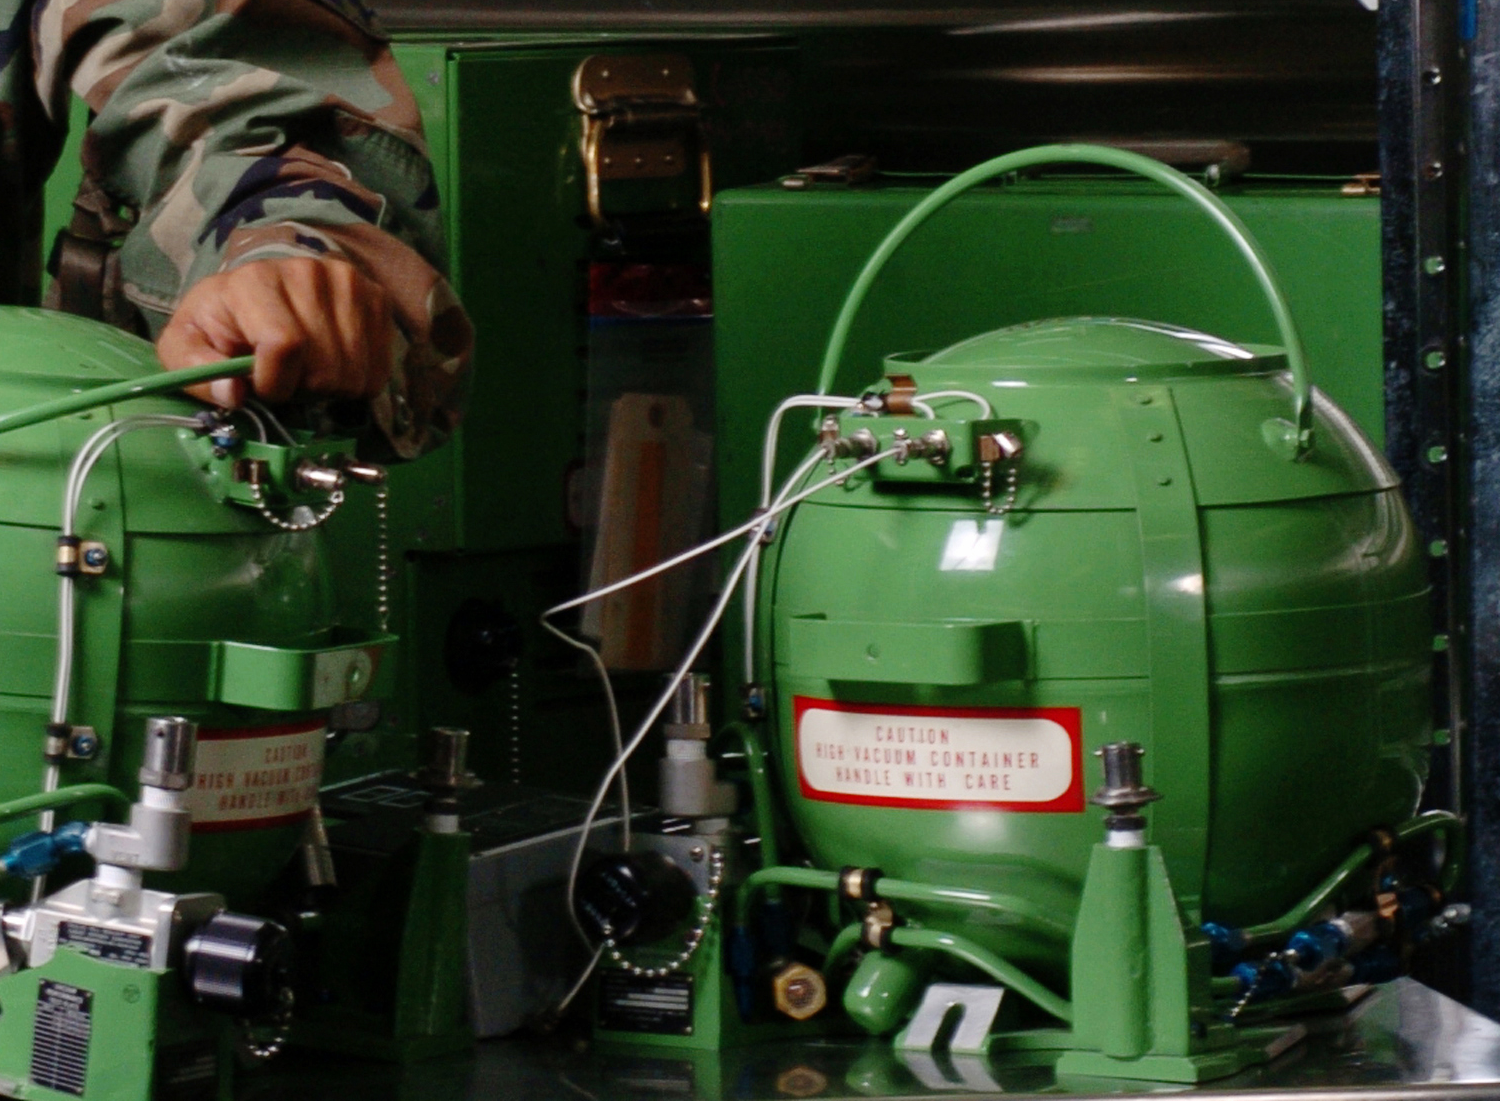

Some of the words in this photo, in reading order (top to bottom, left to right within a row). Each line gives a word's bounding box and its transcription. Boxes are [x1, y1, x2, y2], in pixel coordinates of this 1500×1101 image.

[875, 725, 950, 746] CAUTION
[815, 742, 846, 761] HIGH
[854, 746, 917, 766] VACUUM
[930, 751, 1040, 769] CONTAINER
[835, 766, 892, 787] HANDLE
[904, 771, 947, 789] WITH
[965, 774, 1012, 791] CARE
